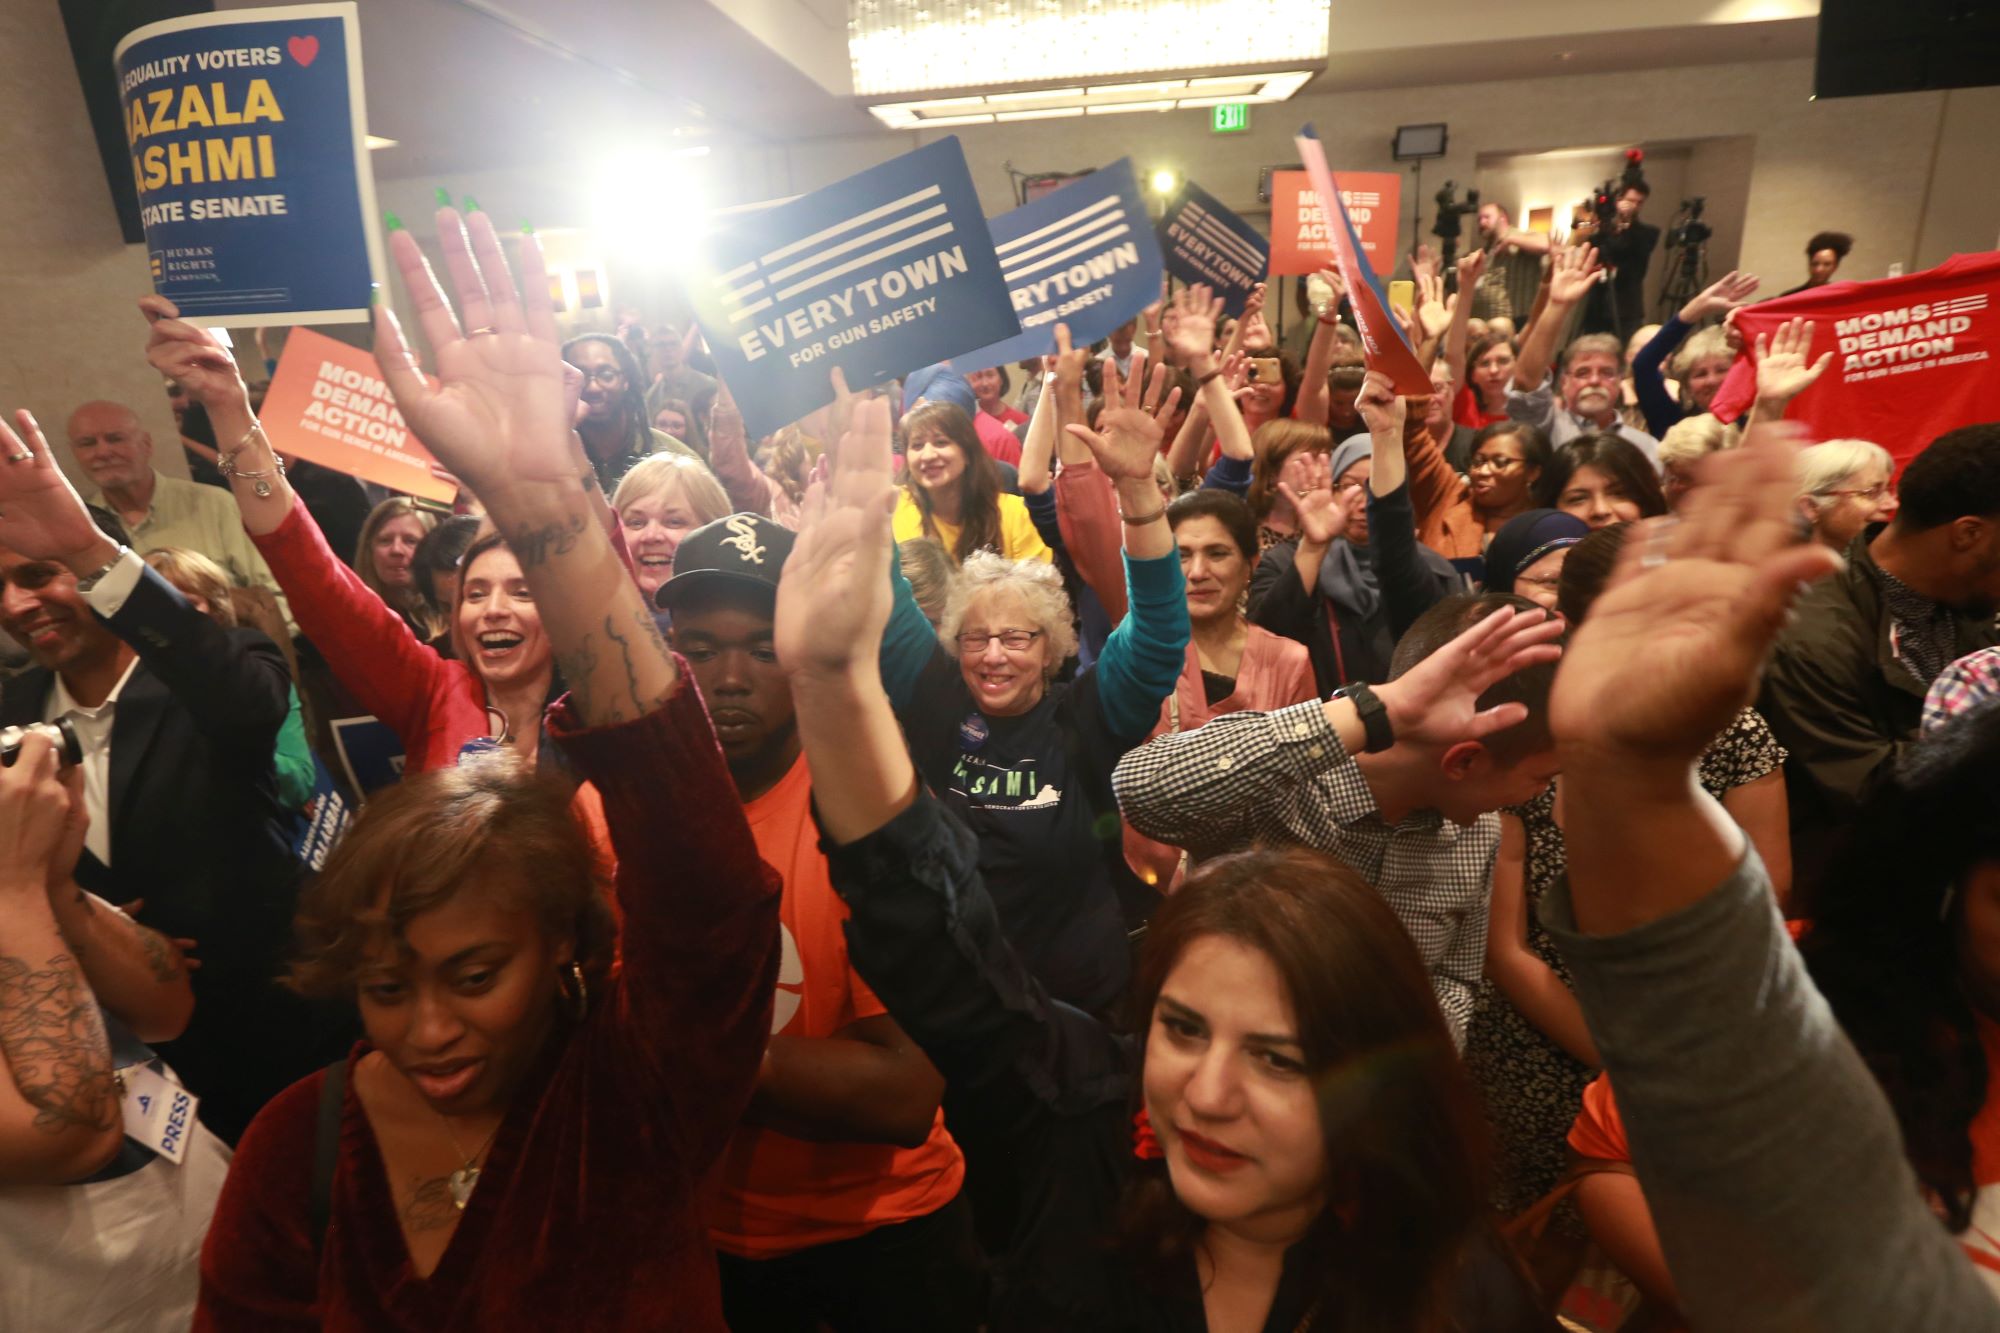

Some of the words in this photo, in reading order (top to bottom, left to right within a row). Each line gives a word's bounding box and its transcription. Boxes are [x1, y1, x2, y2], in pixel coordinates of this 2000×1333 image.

[125, 54, 190, 90] EQUALITY
[196, 46, 282, 70] VOTERS
[1216, 104, 1245, 129] EXIT
[134, 135, 276, 193] ASHMI
[190, 194, 288, 220] SENATE
[166, 246, 213, 258] HUMAN
[167, 259, 216, 271] RIGHTS
[1167, 223, 1254, 289] EVERYTOWN
[1009, 241, 1139, 311] RYTOWN
[738, 245, 968, 362] EVERYTOWN
[1057, 284, 1113, 316] SAFETY
[1834, 304, 1931, 336] MOMS
[789, 342, 826, 368] FOR
[828, 325, 868, 349] GUN
[868, 297, 936, 334] SAFETY
[1839, 316, 1971, 354] DEMAND
[1843, 336, 1954, 372] ACTION
[304, 400, 407, 448] ACTION
[311, 380, 406, 428] DEMAN
[310, 790, 343, 872] EVERYTO
[161, 1091, 190, 1155] PRESS
